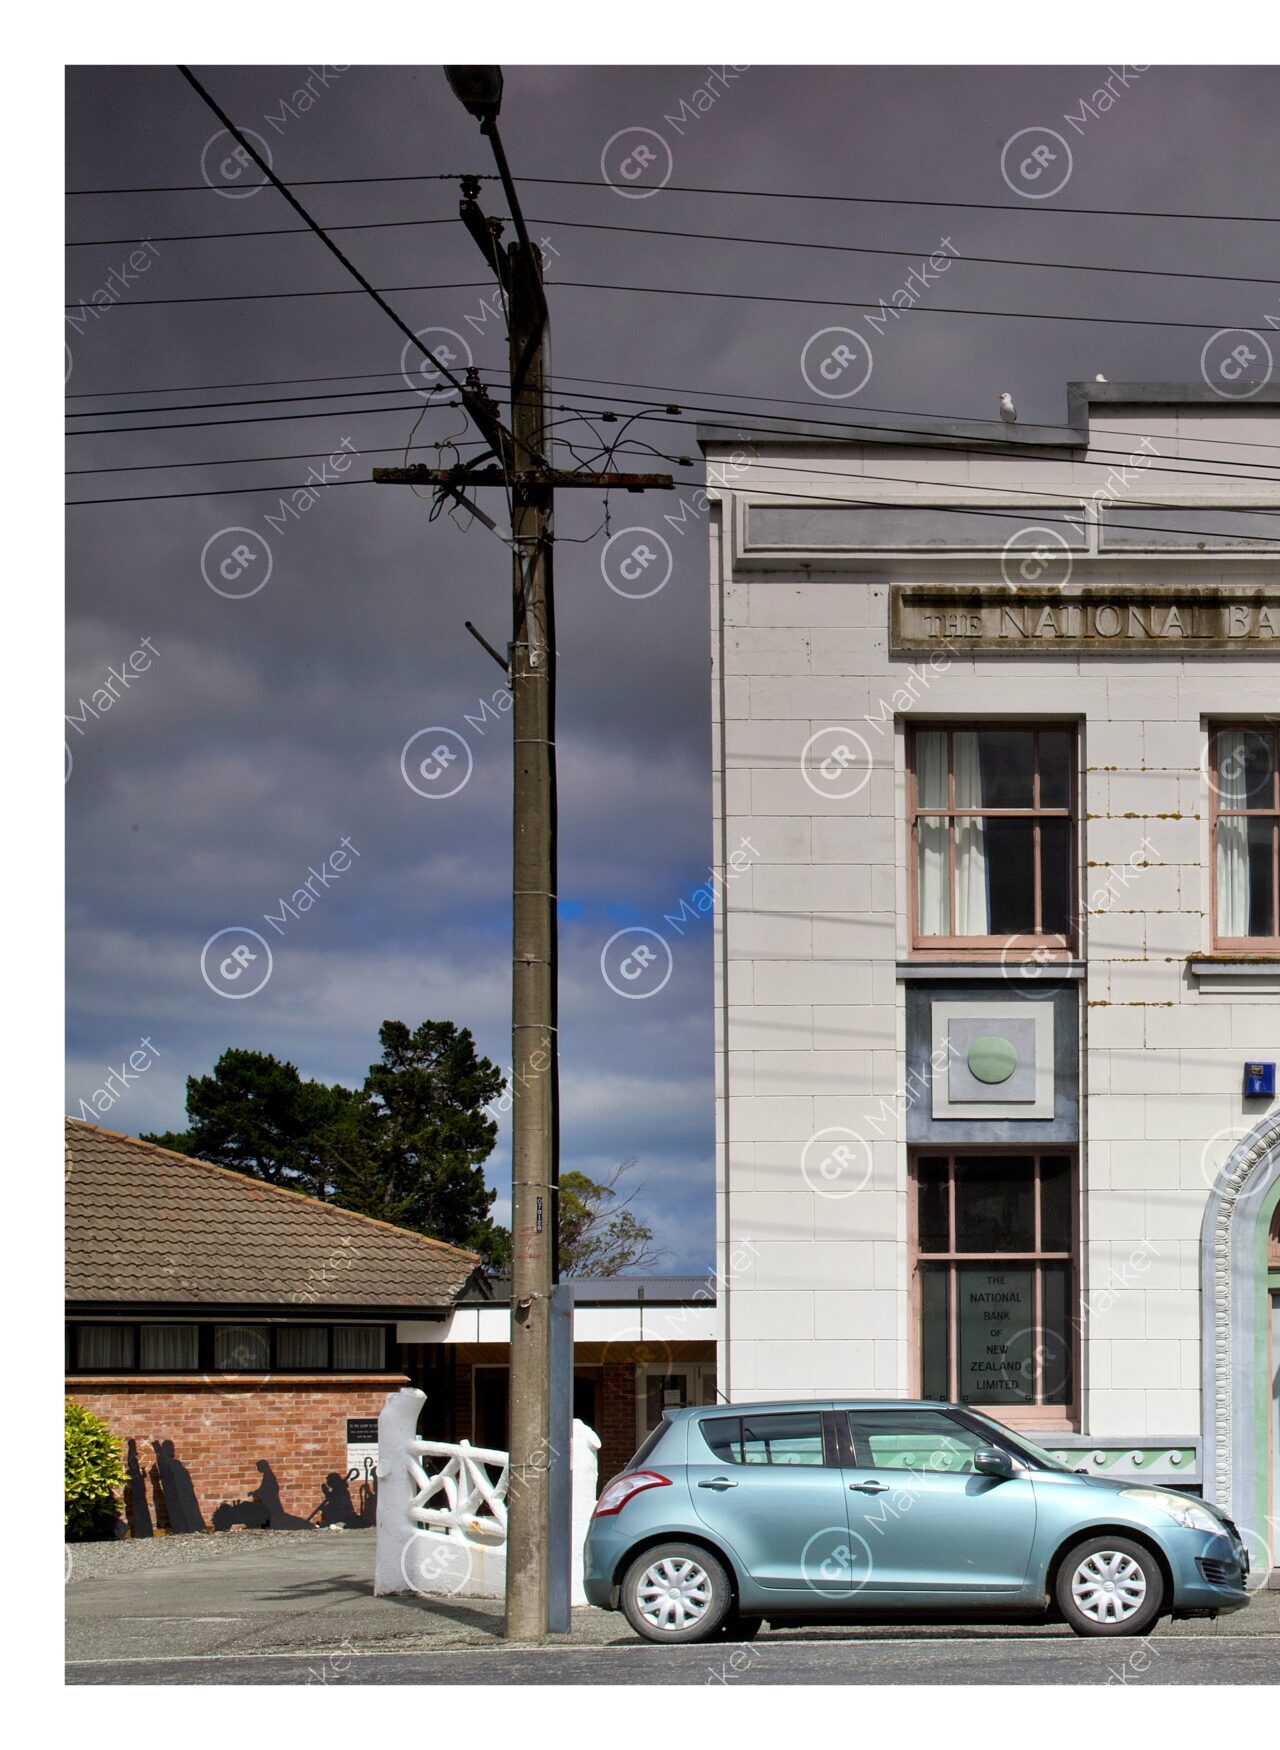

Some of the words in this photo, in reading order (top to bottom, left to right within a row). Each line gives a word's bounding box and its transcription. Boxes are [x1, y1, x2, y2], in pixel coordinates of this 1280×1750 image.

[923, 614, 982, 639] THE
[1000, 604, 1214, 639] NATIONAL
[986, 1276, 1007, 1285] THE
[970, 1292, 1022, 1303] NATIONAL
[983, 1311, 1011, 1321] BANK
[990, 1328, 1003, 1337] OF
[986, 1345, 1009, 1355] NEW
[970, 1361, 1022, 1372] ZEALAND
[976, 1380, 1019, 1390] LIMITED
